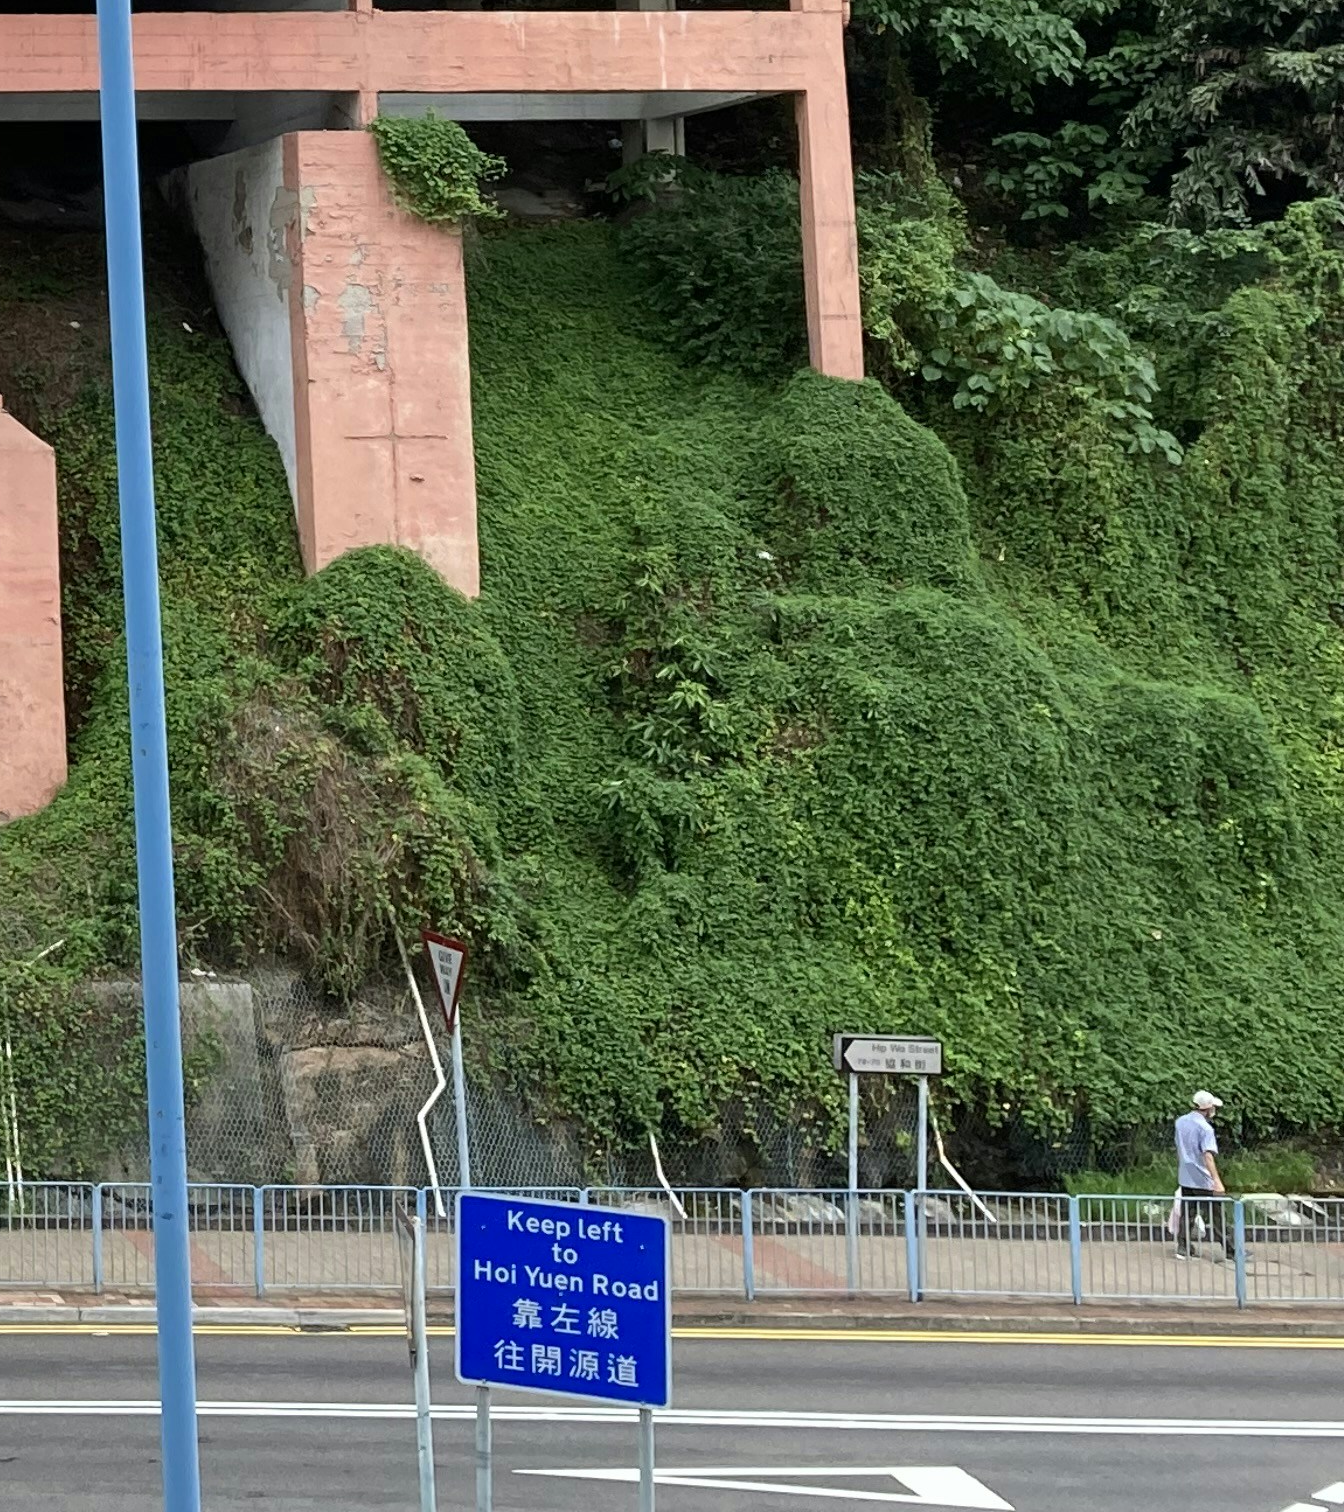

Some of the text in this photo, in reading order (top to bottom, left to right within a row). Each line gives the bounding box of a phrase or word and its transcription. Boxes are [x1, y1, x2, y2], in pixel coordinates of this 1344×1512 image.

[908, 1044, 939, 1054] Street
[507, 1210, 624, 1243] Keep left
[551, 1242, 578, 1265] to
[474, 1259, 659, 1301] Hoi Yuen Road
[512, 1298, 619, 1339] 靠左線
[494, 1339, 639, 1387] 往開源道
